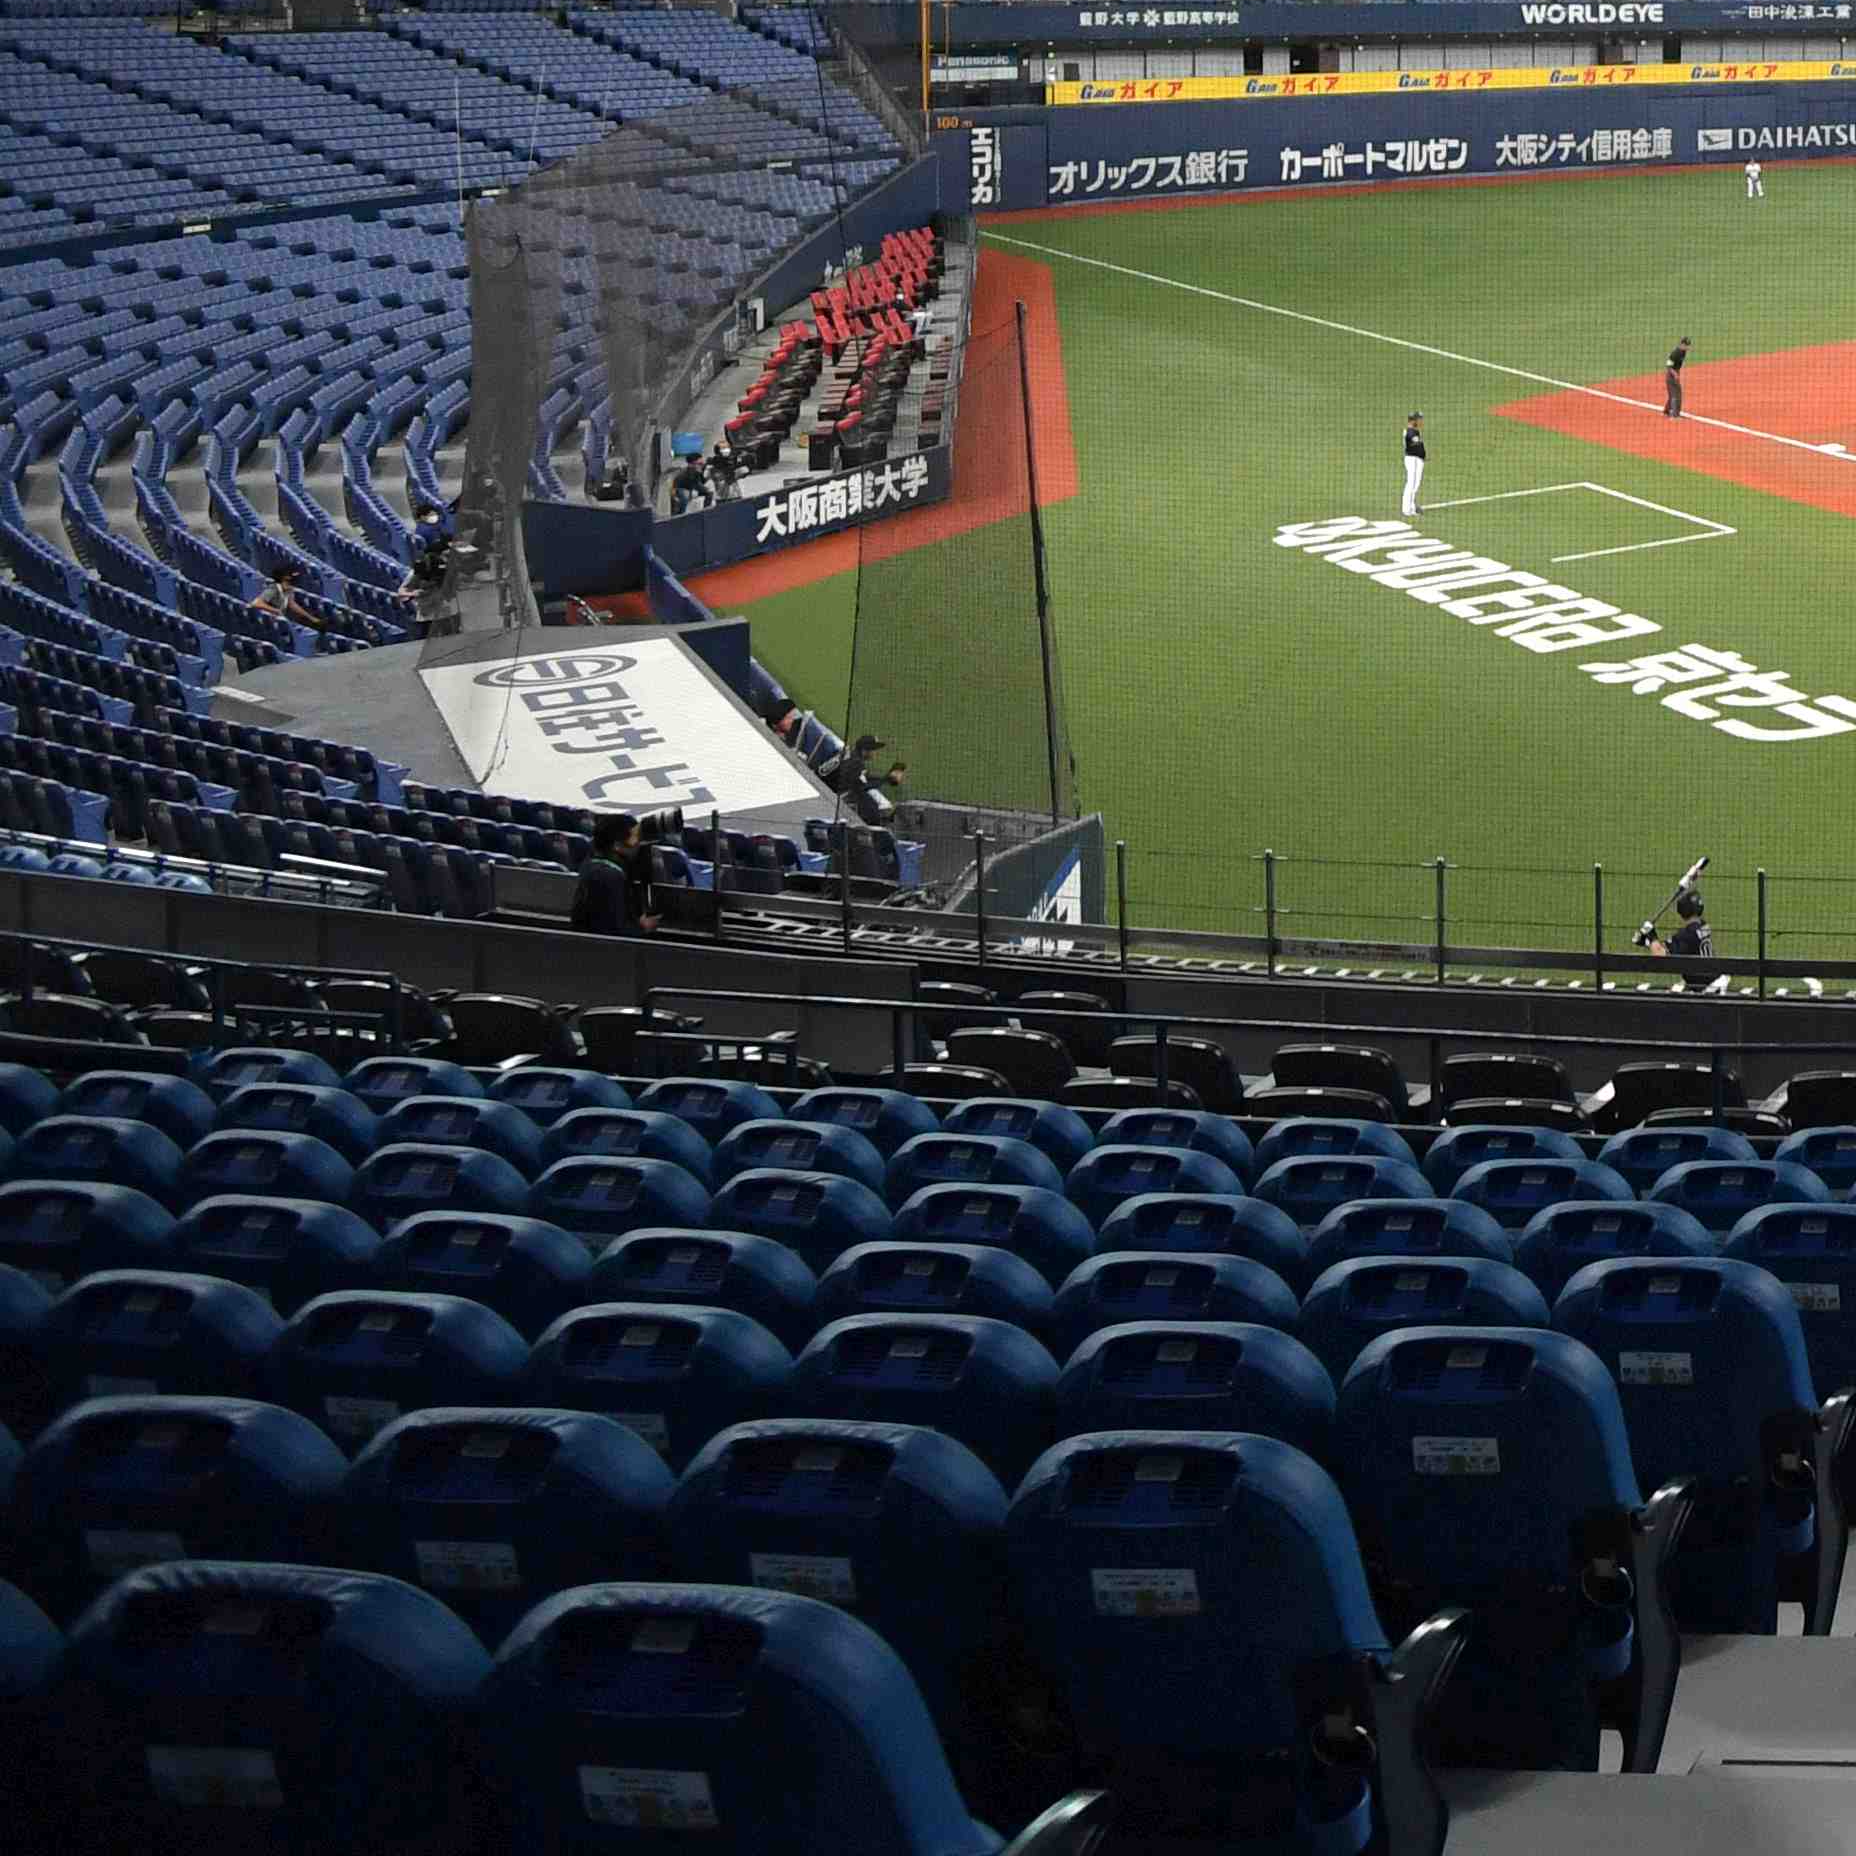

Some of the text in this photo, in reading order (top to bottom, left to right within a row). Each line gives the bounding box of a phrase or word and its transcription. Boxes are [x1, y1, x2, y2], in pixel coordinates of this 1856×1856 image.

[1521, 4, 1664, 24] WORLD EYE
[1281, 75, 1340, 94] ガイア
[1434, 72, 1493, 87] ガイア
[1583, 67, 1635, 82] ガイア
[1724, 64, 1777, 79] ガイア
[1120, 81, 1183, 99] ガイア
[1280, 139, 1468, 182] カーポートマルゼン
[1496, 128, 1672, 167] 大阪シティ信用金庫
[971, 128, 993, 204] エコリカ
[1049, 149, 1248, 196] オリックス銀行
[756, 455, 929, 544] 大阪商業大学
[1303, 519, 1663, 653] KYOCERA
